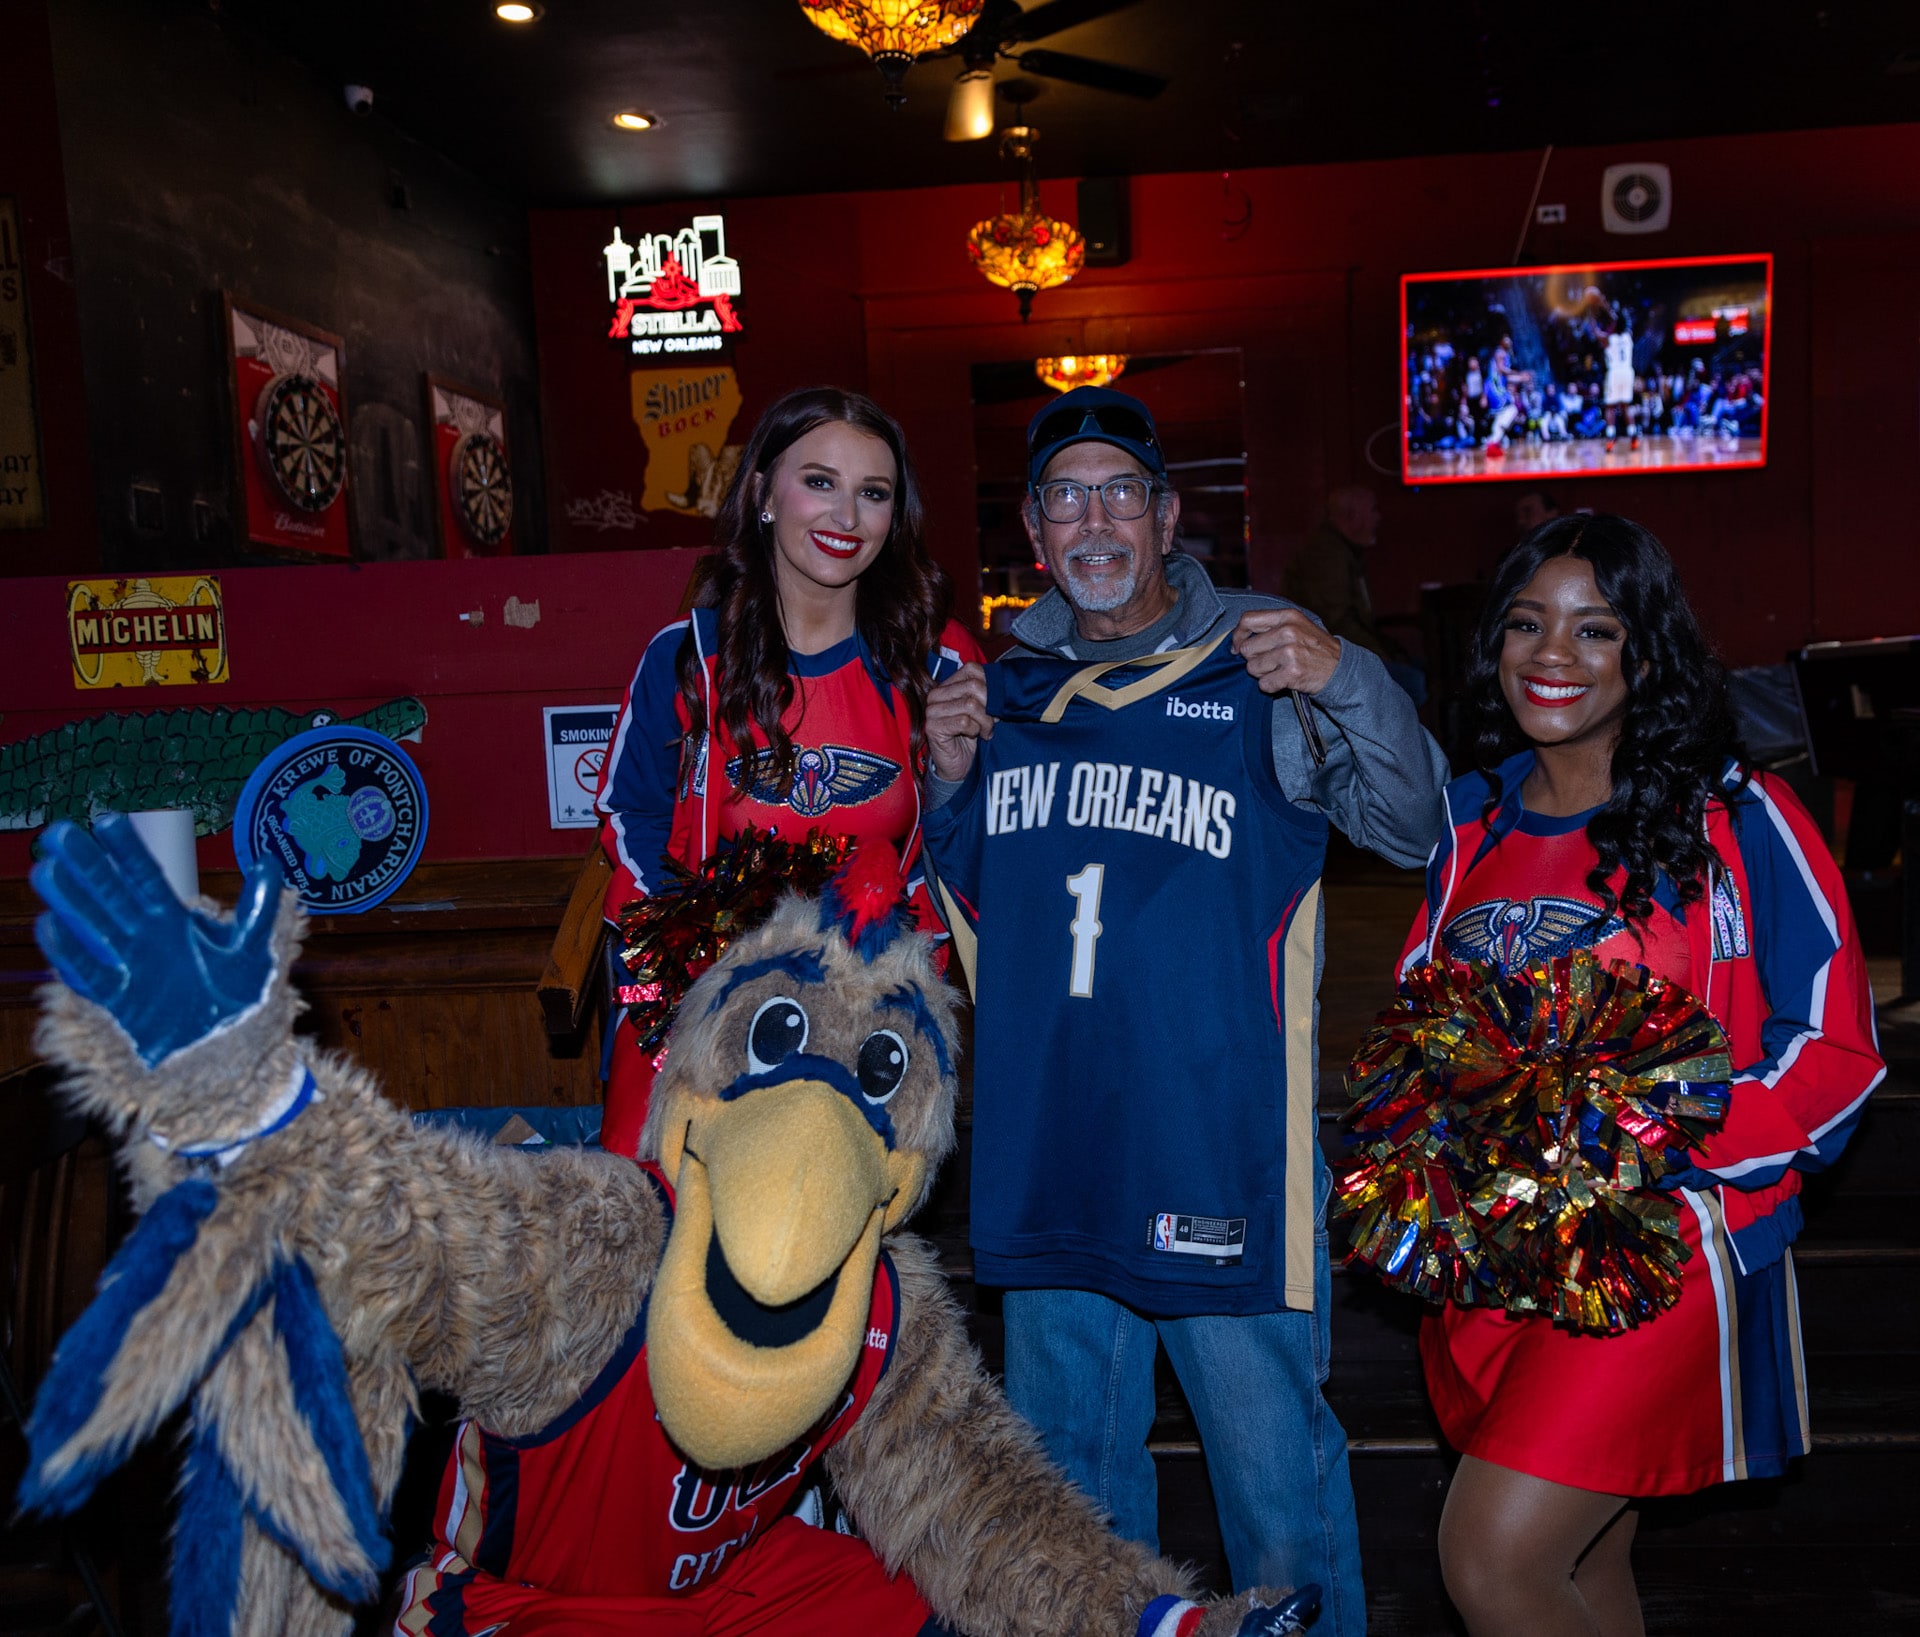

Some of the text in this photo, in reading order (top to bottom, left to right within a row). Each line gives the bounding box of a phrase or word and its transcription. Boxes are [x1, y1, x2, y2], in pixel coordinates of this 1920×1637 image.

[631, 309, 722, 337] STELLA
[632, 335, 722, 354] NEW ORLEANS
[644, 373, 727, 424] Shiner
[658, 408, 717, 437] BOCK
[76, 612, 216, 647] MICHELIN
[1166, 696, 1235, 721] ibotta
[271, 749, 413, 901] KREWE OF PONTCHARTRAIN
[986, 761, 1237, 860] NEW ORLEANS
[267, 814, 310, 889] ORGANIZED 1975
[1066, 862, 1105, 999] 1
